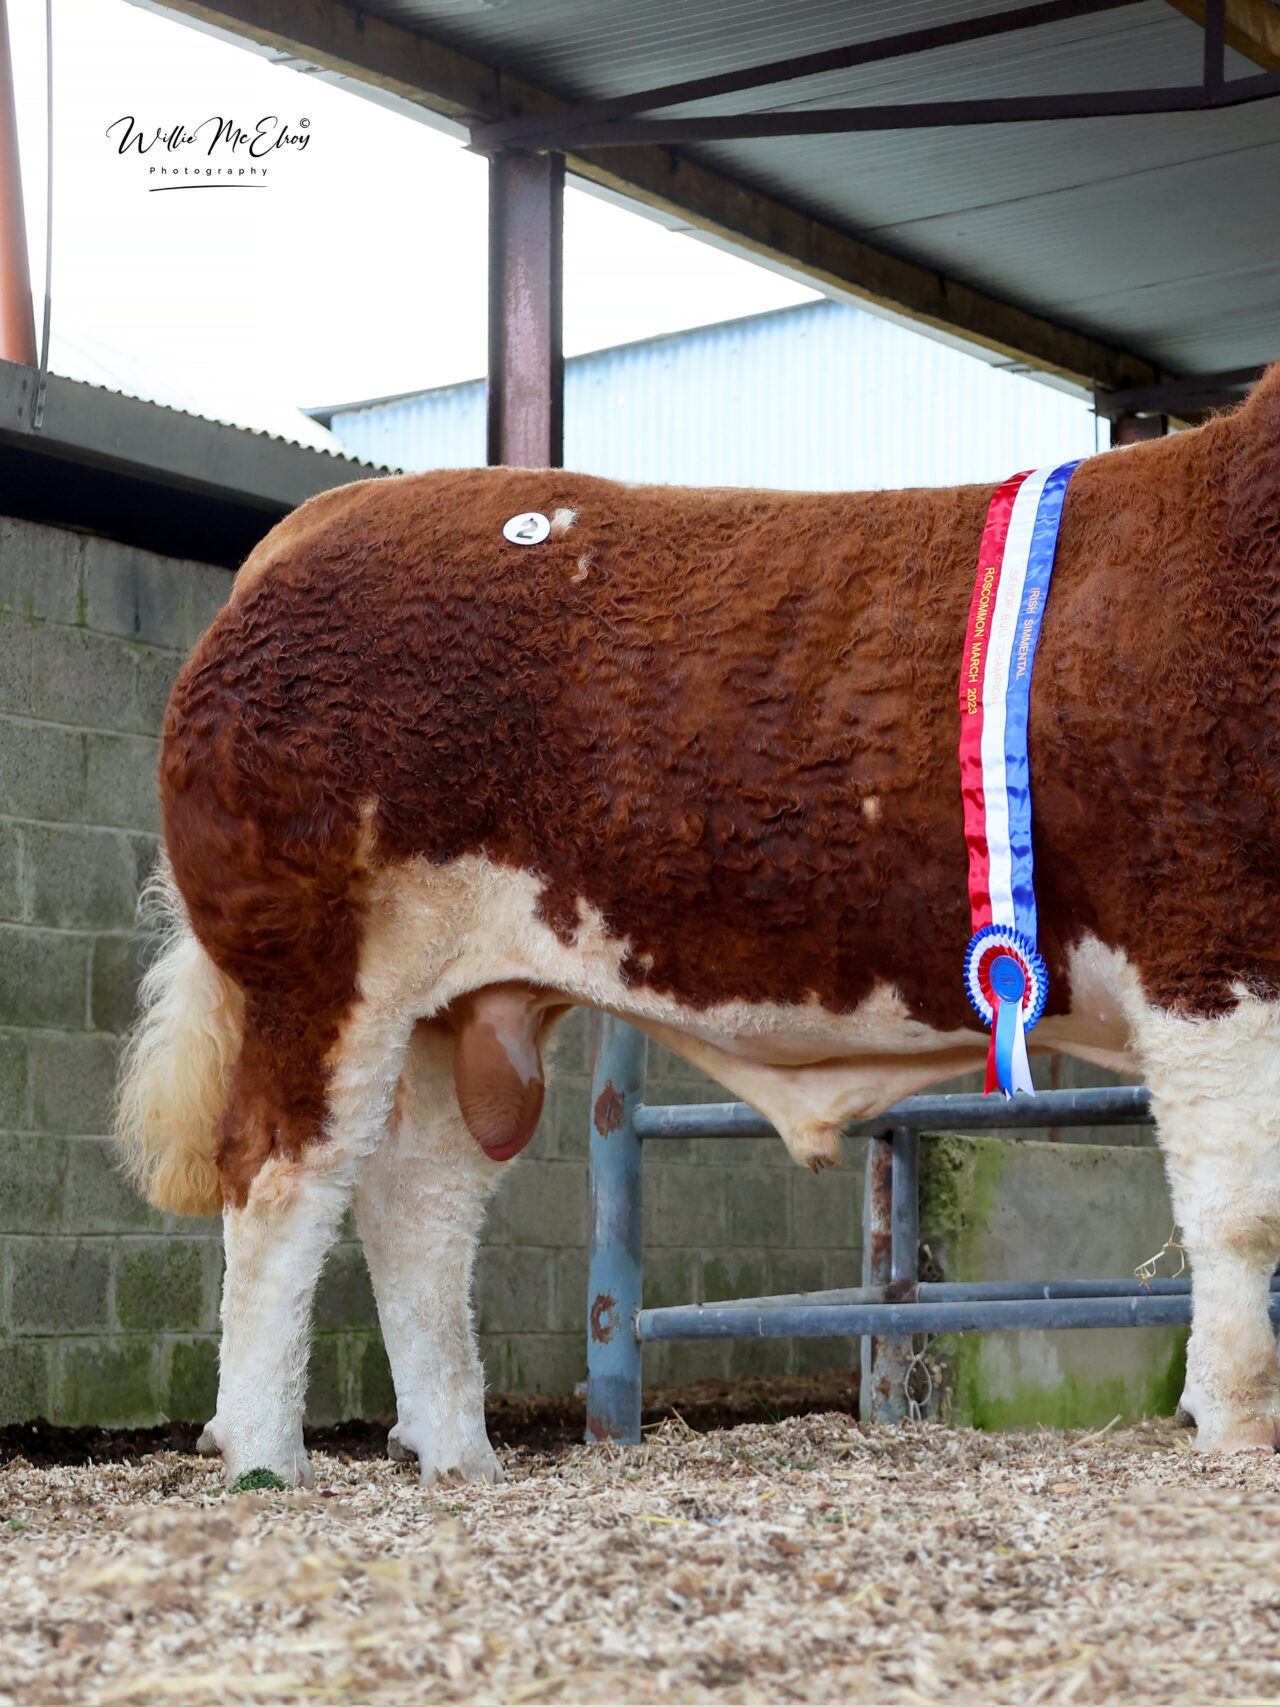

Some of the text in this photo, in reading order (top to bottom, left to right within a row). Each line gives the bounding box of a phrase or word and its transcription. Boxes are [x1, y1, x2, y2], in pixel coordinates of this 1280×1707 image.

[516, 519, 538, 539] 2
[967, 567, 996, 715] ROSCOMMON MARCH 2023
[1016, 587, 1041, 680] IRISH SIMMENTAL
